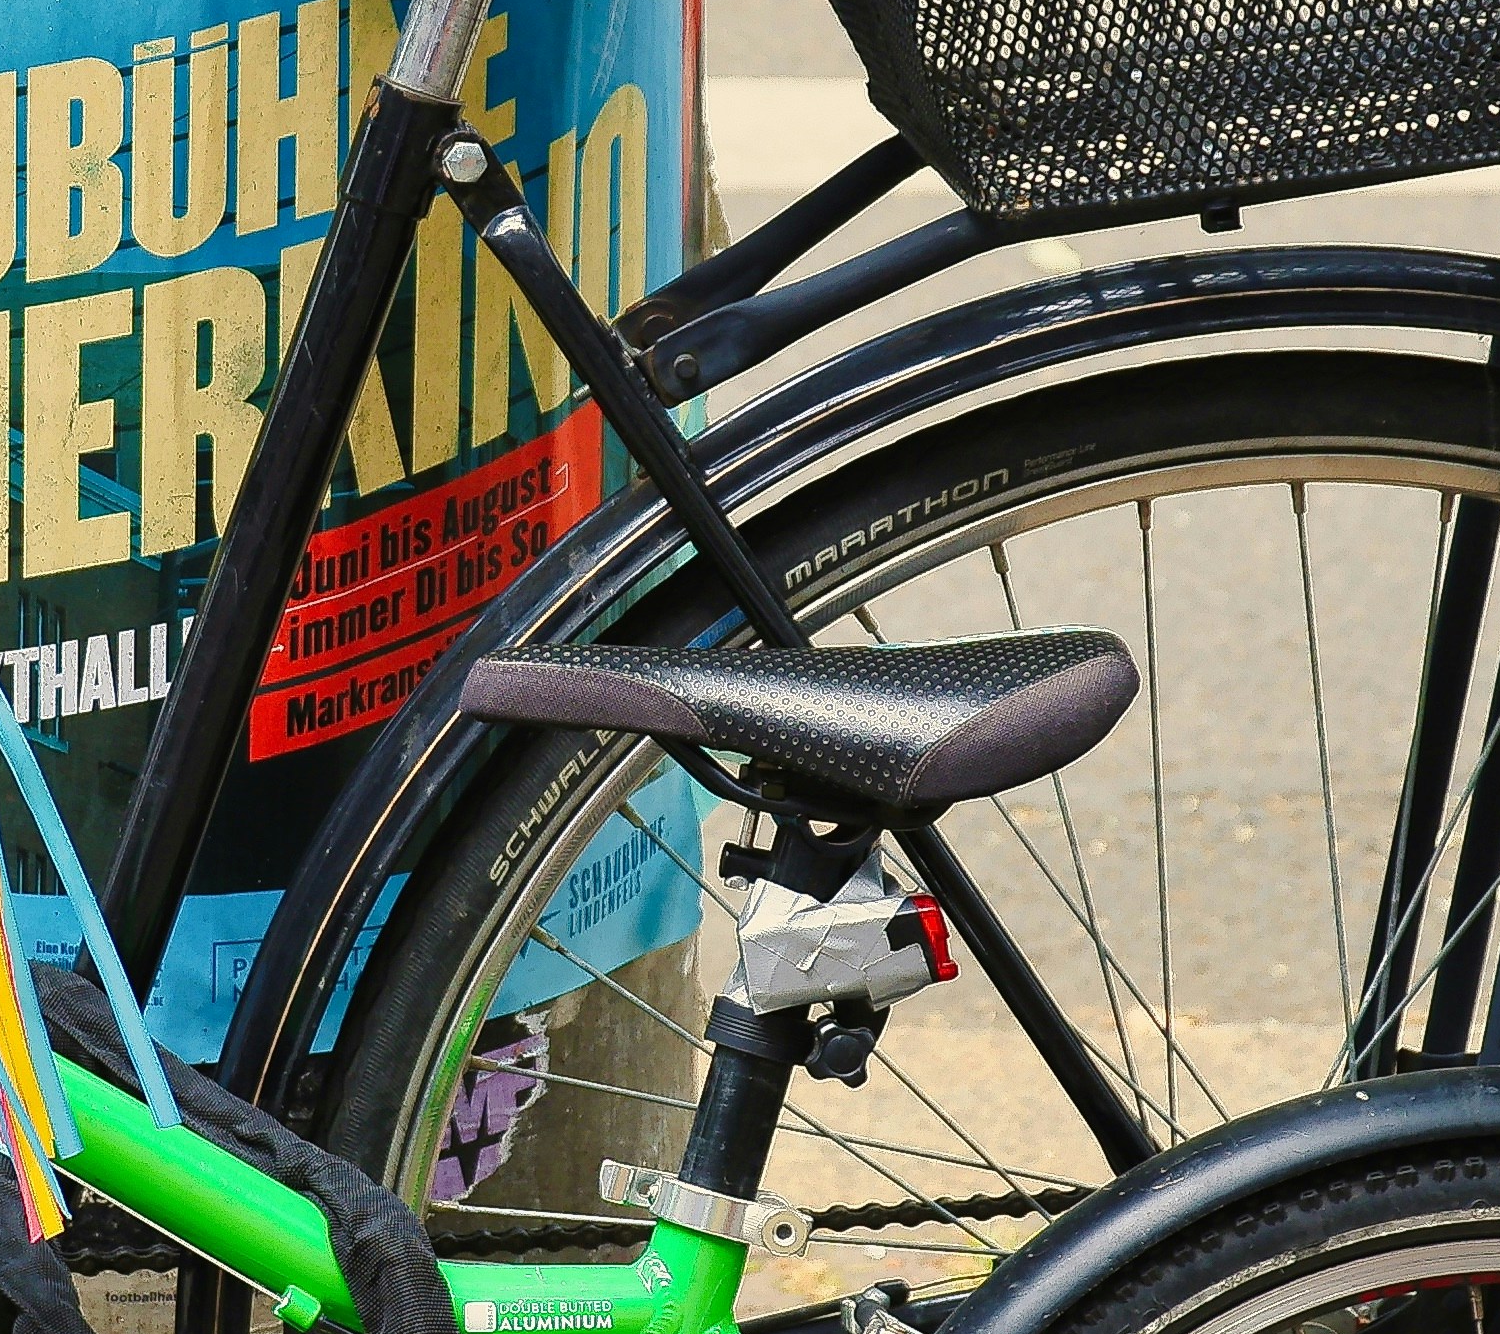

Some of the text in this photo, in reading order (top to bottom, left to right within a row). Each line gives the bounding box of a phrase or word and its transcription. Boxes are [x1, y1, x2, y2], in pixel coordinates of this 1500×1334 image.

[291, 455, 552, 601] Juni bis August
[785, 468, 1010, 589] MARATHON
[288, 517, 548, 662] immer Di bis So
[568, 869, 642, 939] LINDENFELS
[499, 1314, 614, 1332] ALUMINIUM
[500, 1299, 613, 1315] DOUBLE BUTTED
